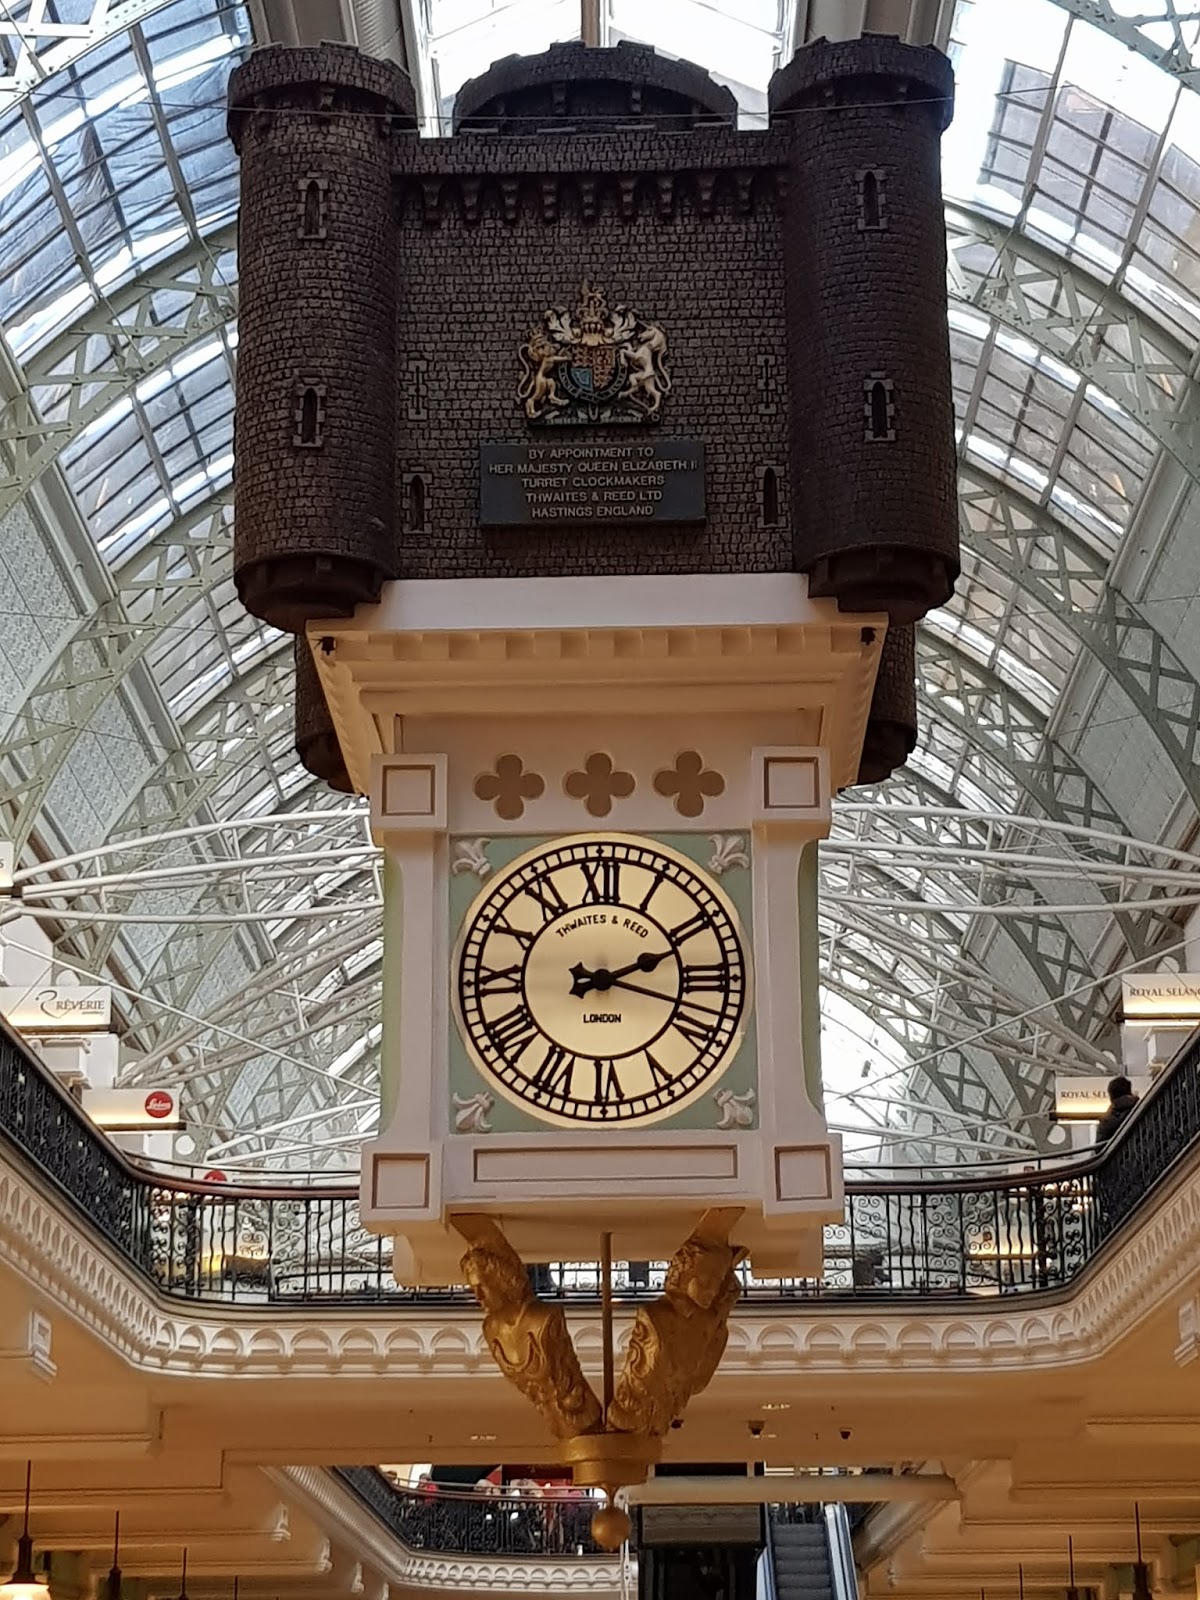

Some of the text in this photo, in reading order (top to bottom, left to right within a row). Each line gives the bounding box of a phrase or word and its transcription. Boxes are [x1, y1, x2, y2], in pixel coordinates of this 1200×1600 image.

[528, 446, 654, 460] BY APPOINTMENT TO
[488, 459, 698, 474] HER MAJESTY QUEEN ELIZABETH II
[521, 475, 666, 488] TURRET CLOCKMAKERS
[525, 490, 663, 503] THWAITES & REED LTD
[531, 505, 654, 518] HASTINGS ENGLAND
[580, 860, 621, 904] XII
[524, 876, 569, 923] XI
[491, 913, 537, 951] X
[555, 914, 649, 938] THWAITES & REED
[668, 909, 712, 948] II
[681, 963, 727, 993] III
[1130, 987, 1200, 997] ROYAL SELAN
[583, 1013, 622, 1024] LONDON
[1061, 1090, 1090, 1099] ROYAL
